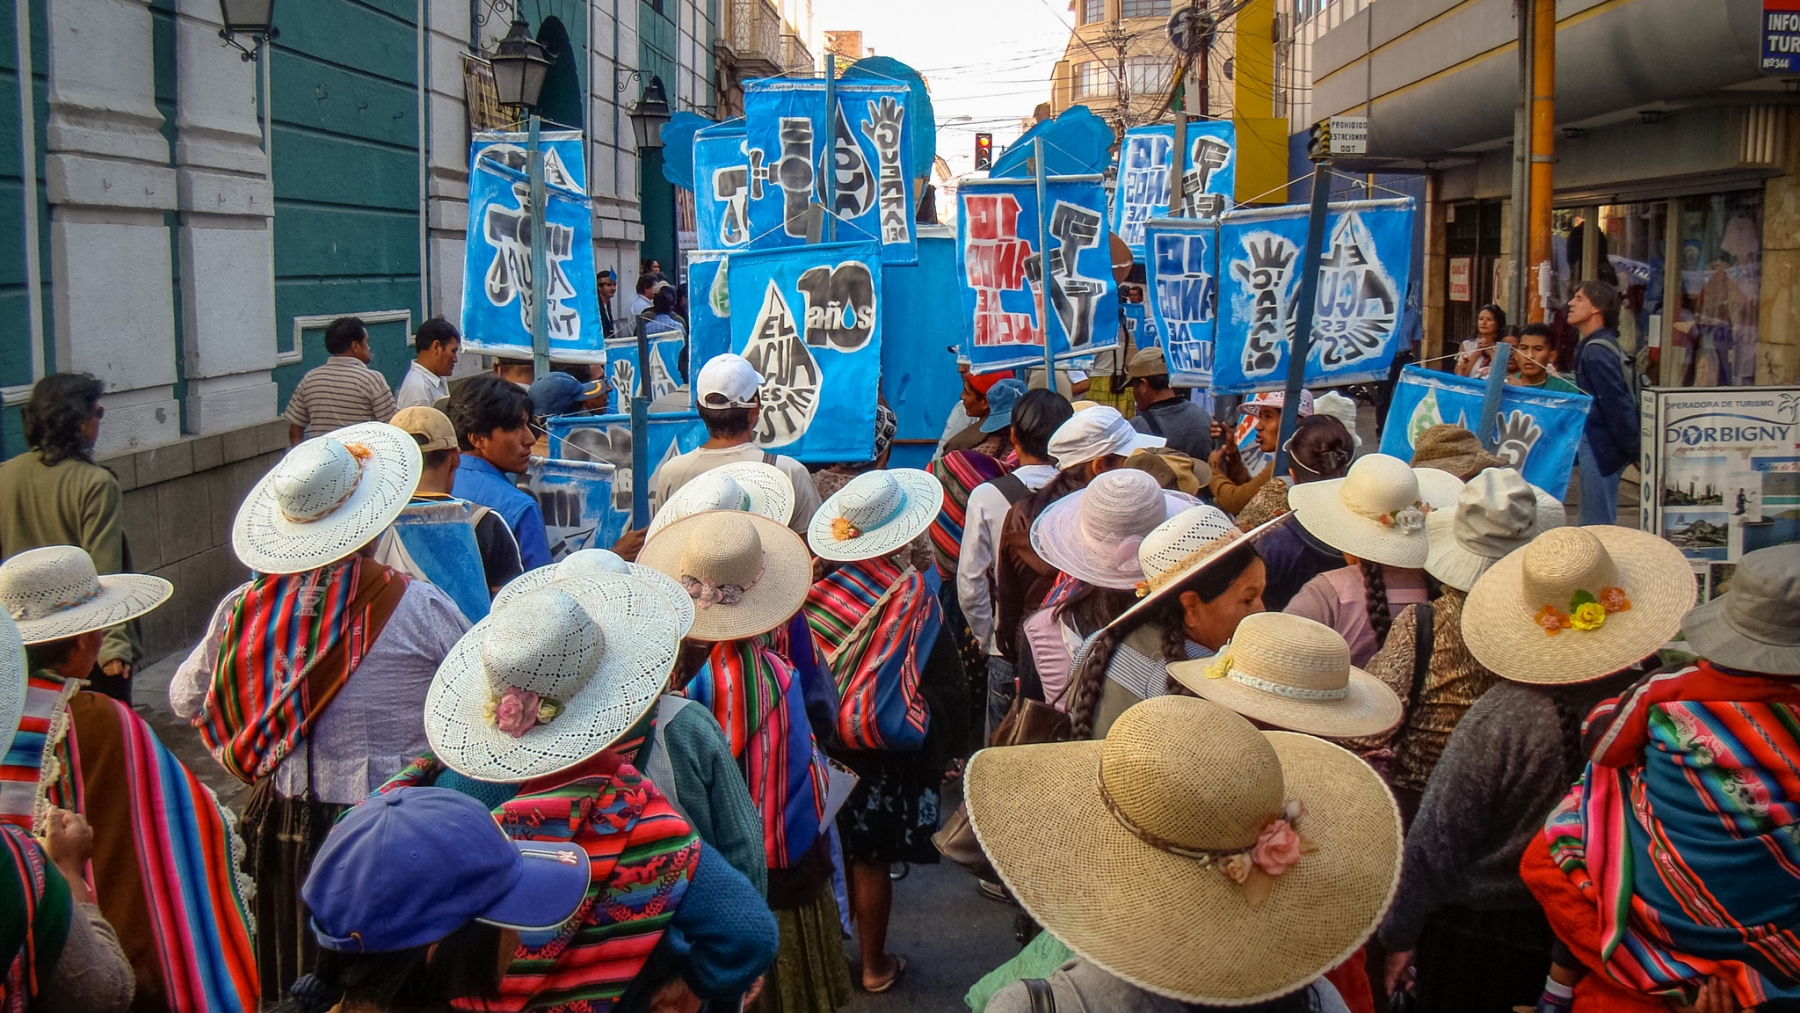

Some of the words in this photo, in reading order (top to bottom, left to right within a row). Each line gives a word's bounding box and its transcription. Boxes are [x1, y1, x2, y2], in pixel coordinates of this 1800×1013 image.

[1768, 13, 1800, 32] INFO
[758, 312, 794, 340] EL
[761, 387, 781, 401] ES
[1666, 401, 1719, 409] OPERADORA
[1735, 399, 1774, 407] TURISMO
